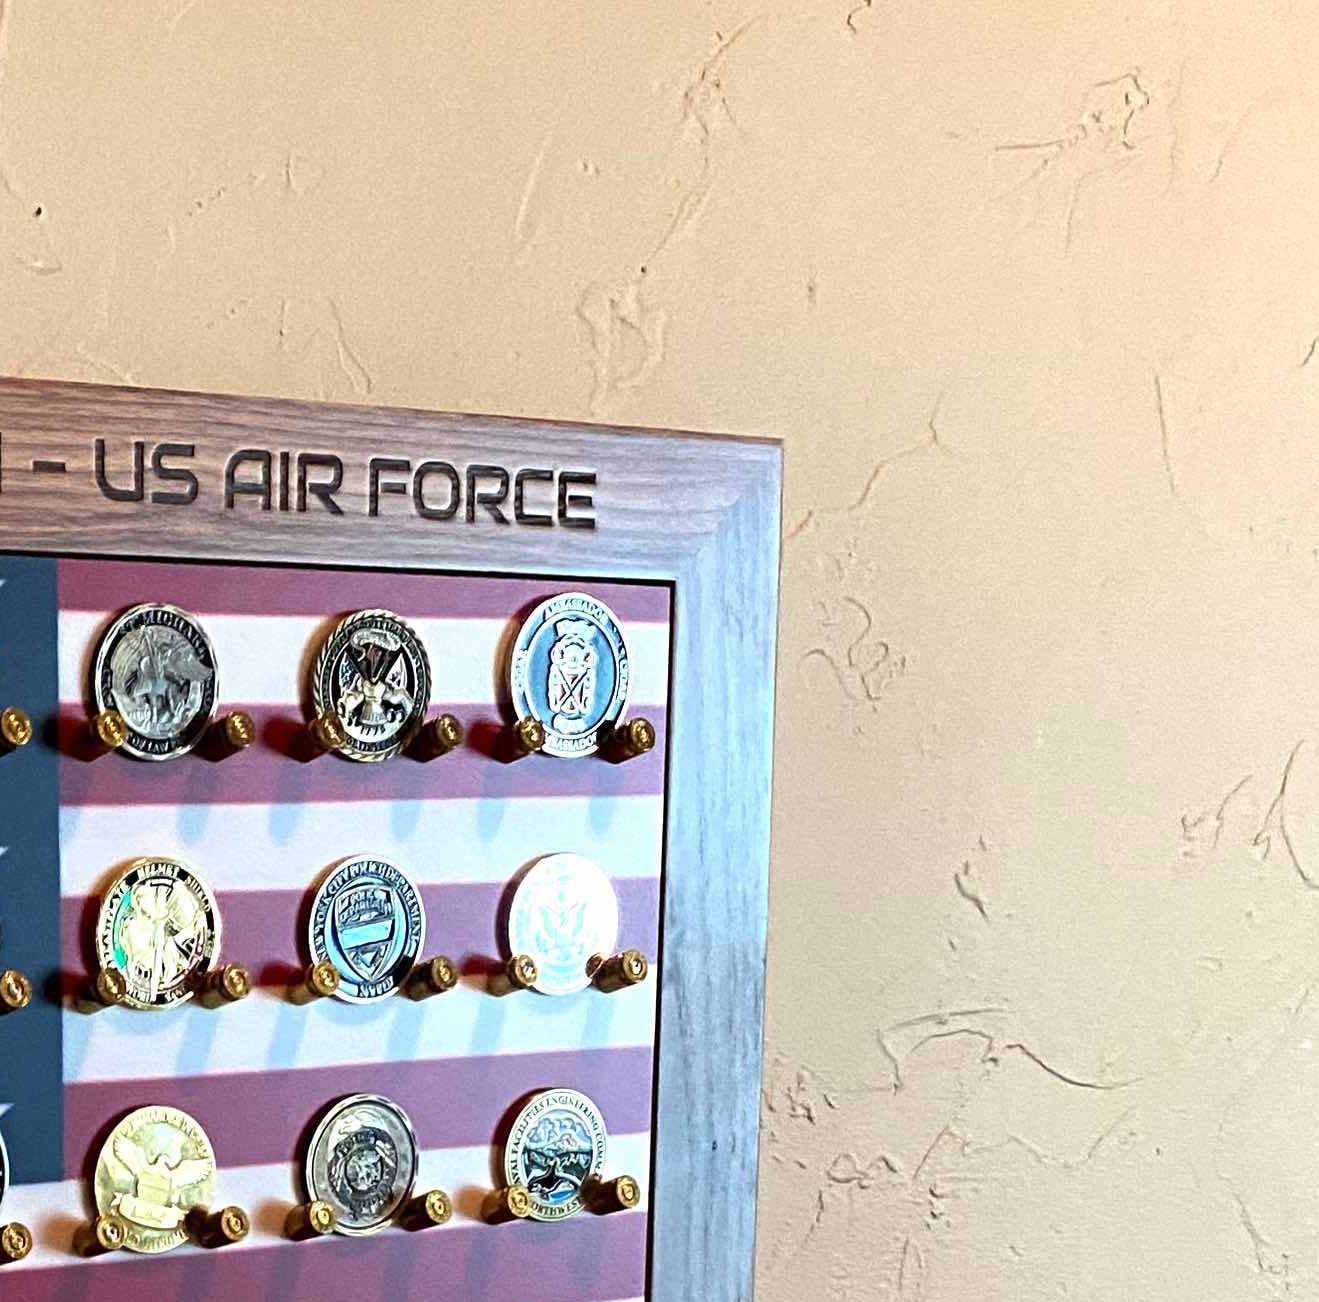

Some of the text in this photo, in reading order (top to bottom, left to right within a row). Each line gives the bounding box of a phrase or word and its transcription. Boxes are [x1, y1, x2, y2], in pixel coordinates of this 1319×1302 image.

[93, 437, 199, 505] US
[224, 448, 345, 515] AIR
[367, 456, 598, 530] FORCE
[530, 1195, 581, 1216] ORTHWEST
